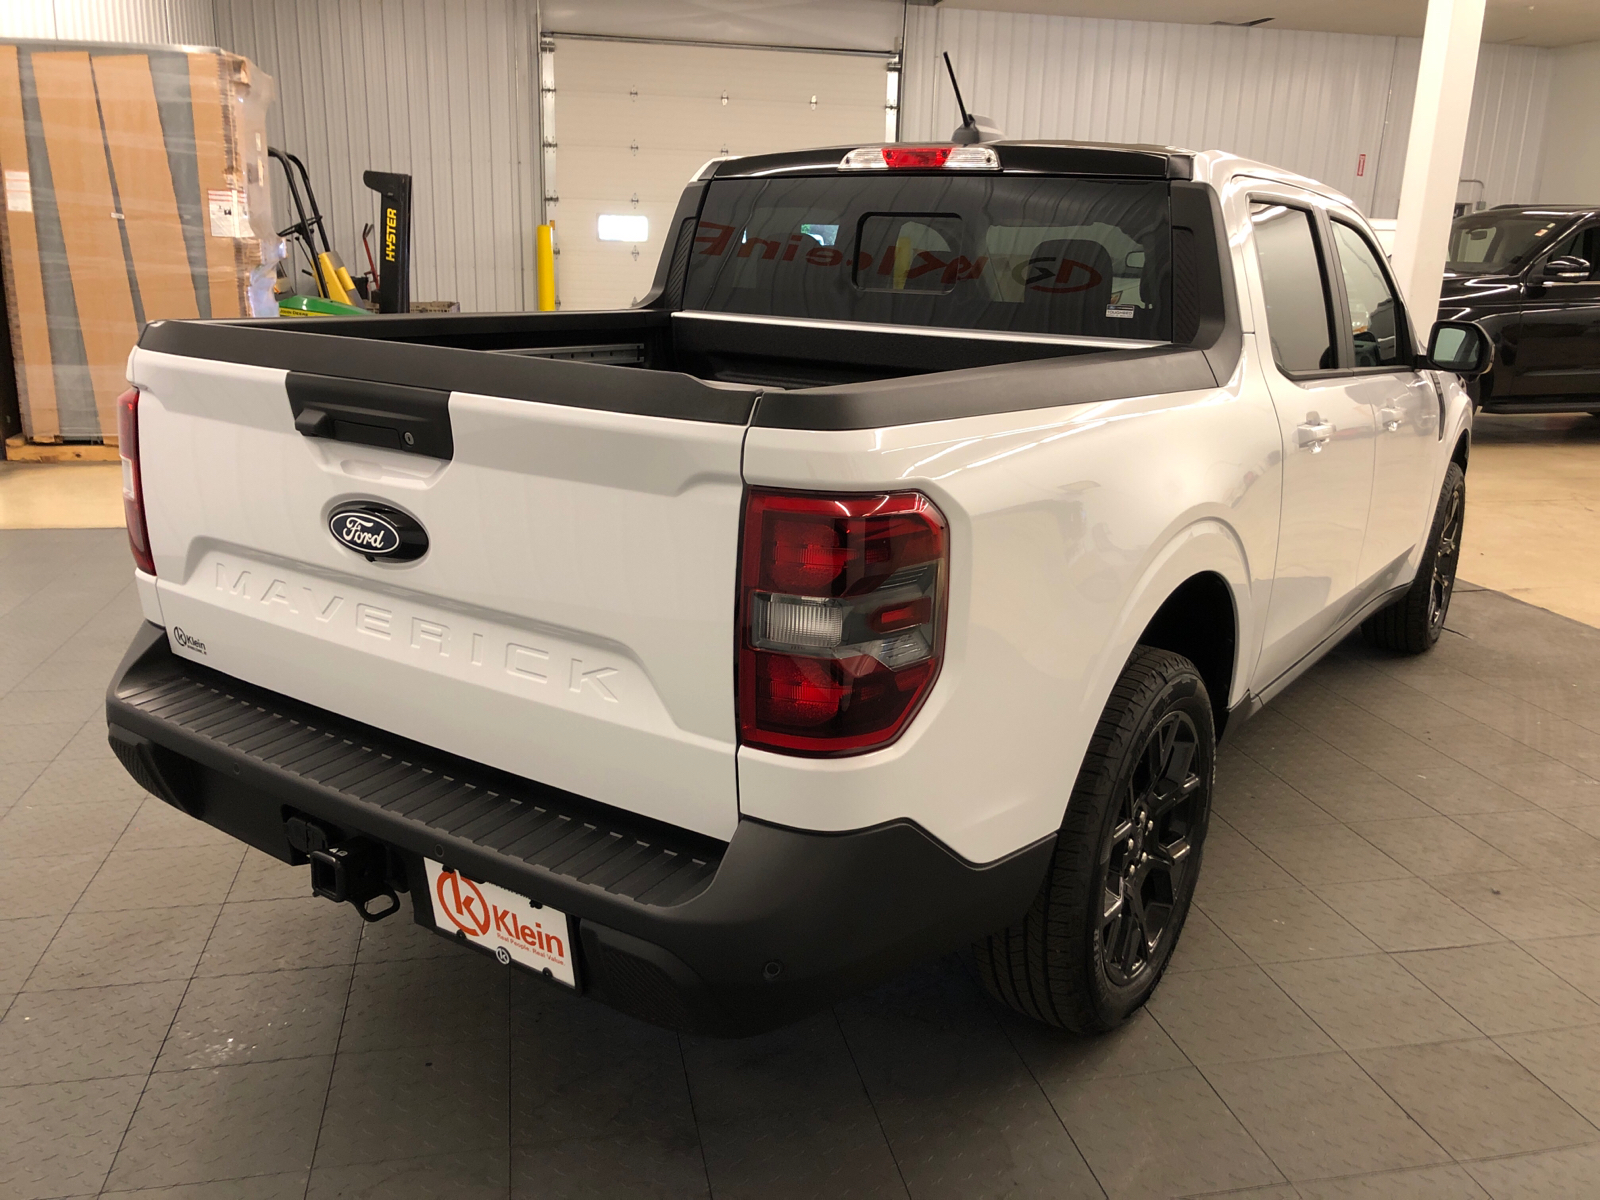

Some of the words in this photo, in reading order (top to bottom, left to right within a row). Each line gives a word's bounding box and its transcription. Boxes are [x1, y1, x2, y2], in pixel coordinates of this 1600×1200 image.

[386, 207, 397, 262] HYSTER
[342, 516, 385, 548] Ford
[186, 634, 206, 650] Klein
[214, 562, 621, 704] MAVERICK
[492, 904, 565, 958] Klein
[496, 932, 509, 943] Real
[532, 948, 546, 958] Real
